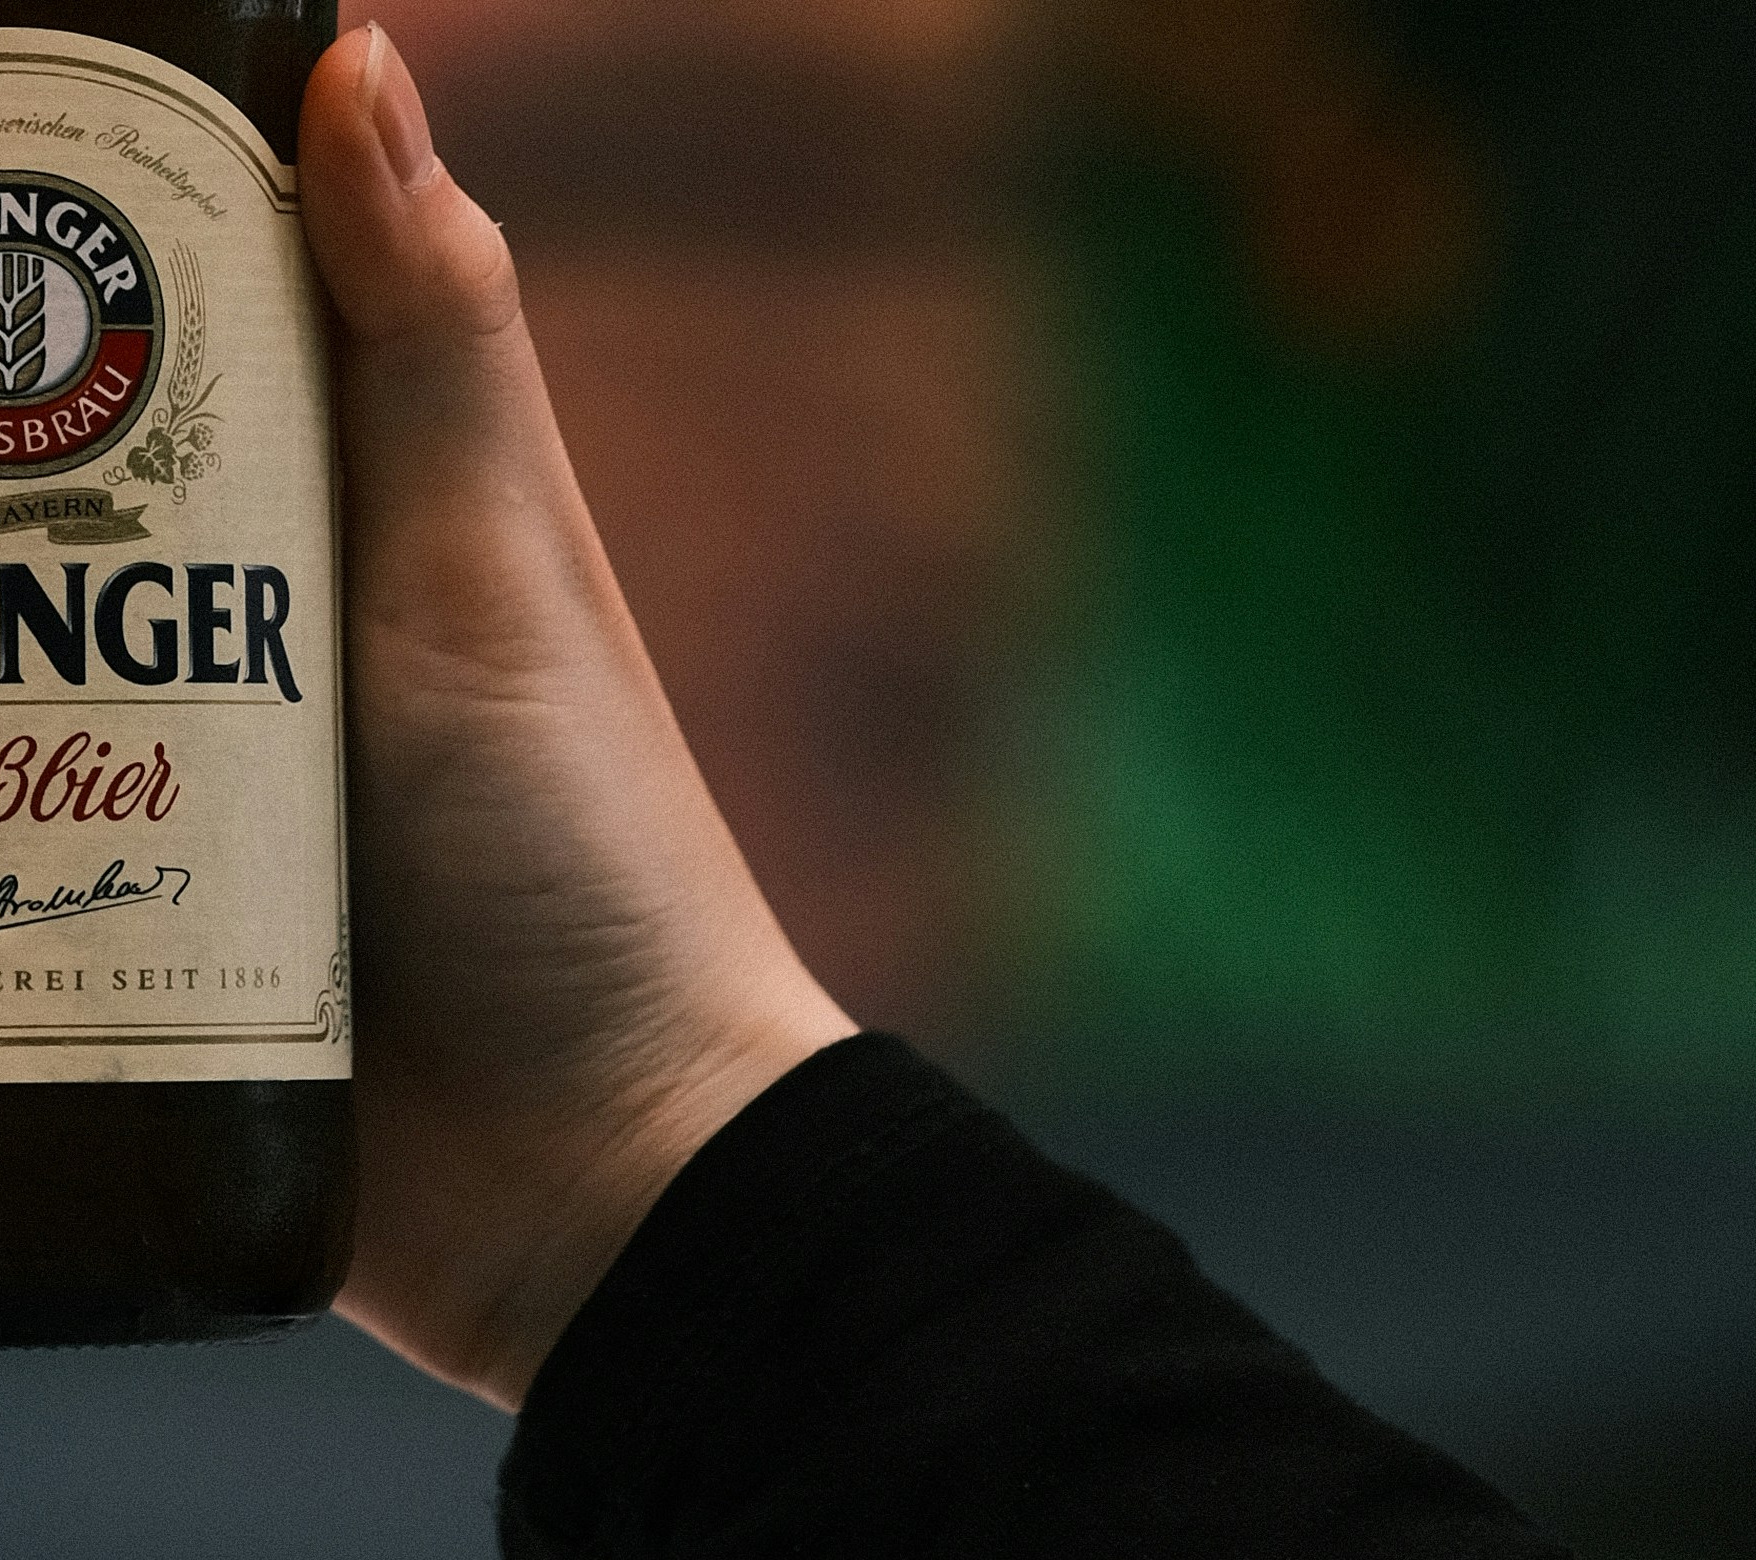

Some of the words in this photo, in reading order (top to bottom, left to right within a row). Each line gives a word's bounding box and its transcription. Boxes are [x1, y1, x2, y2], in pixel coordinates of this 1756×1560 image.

[95, 124, 227, 222] Reinheitsgebot
[112, 967, 201, 990] SEIT
[218, 965, 281, 989] 1886
